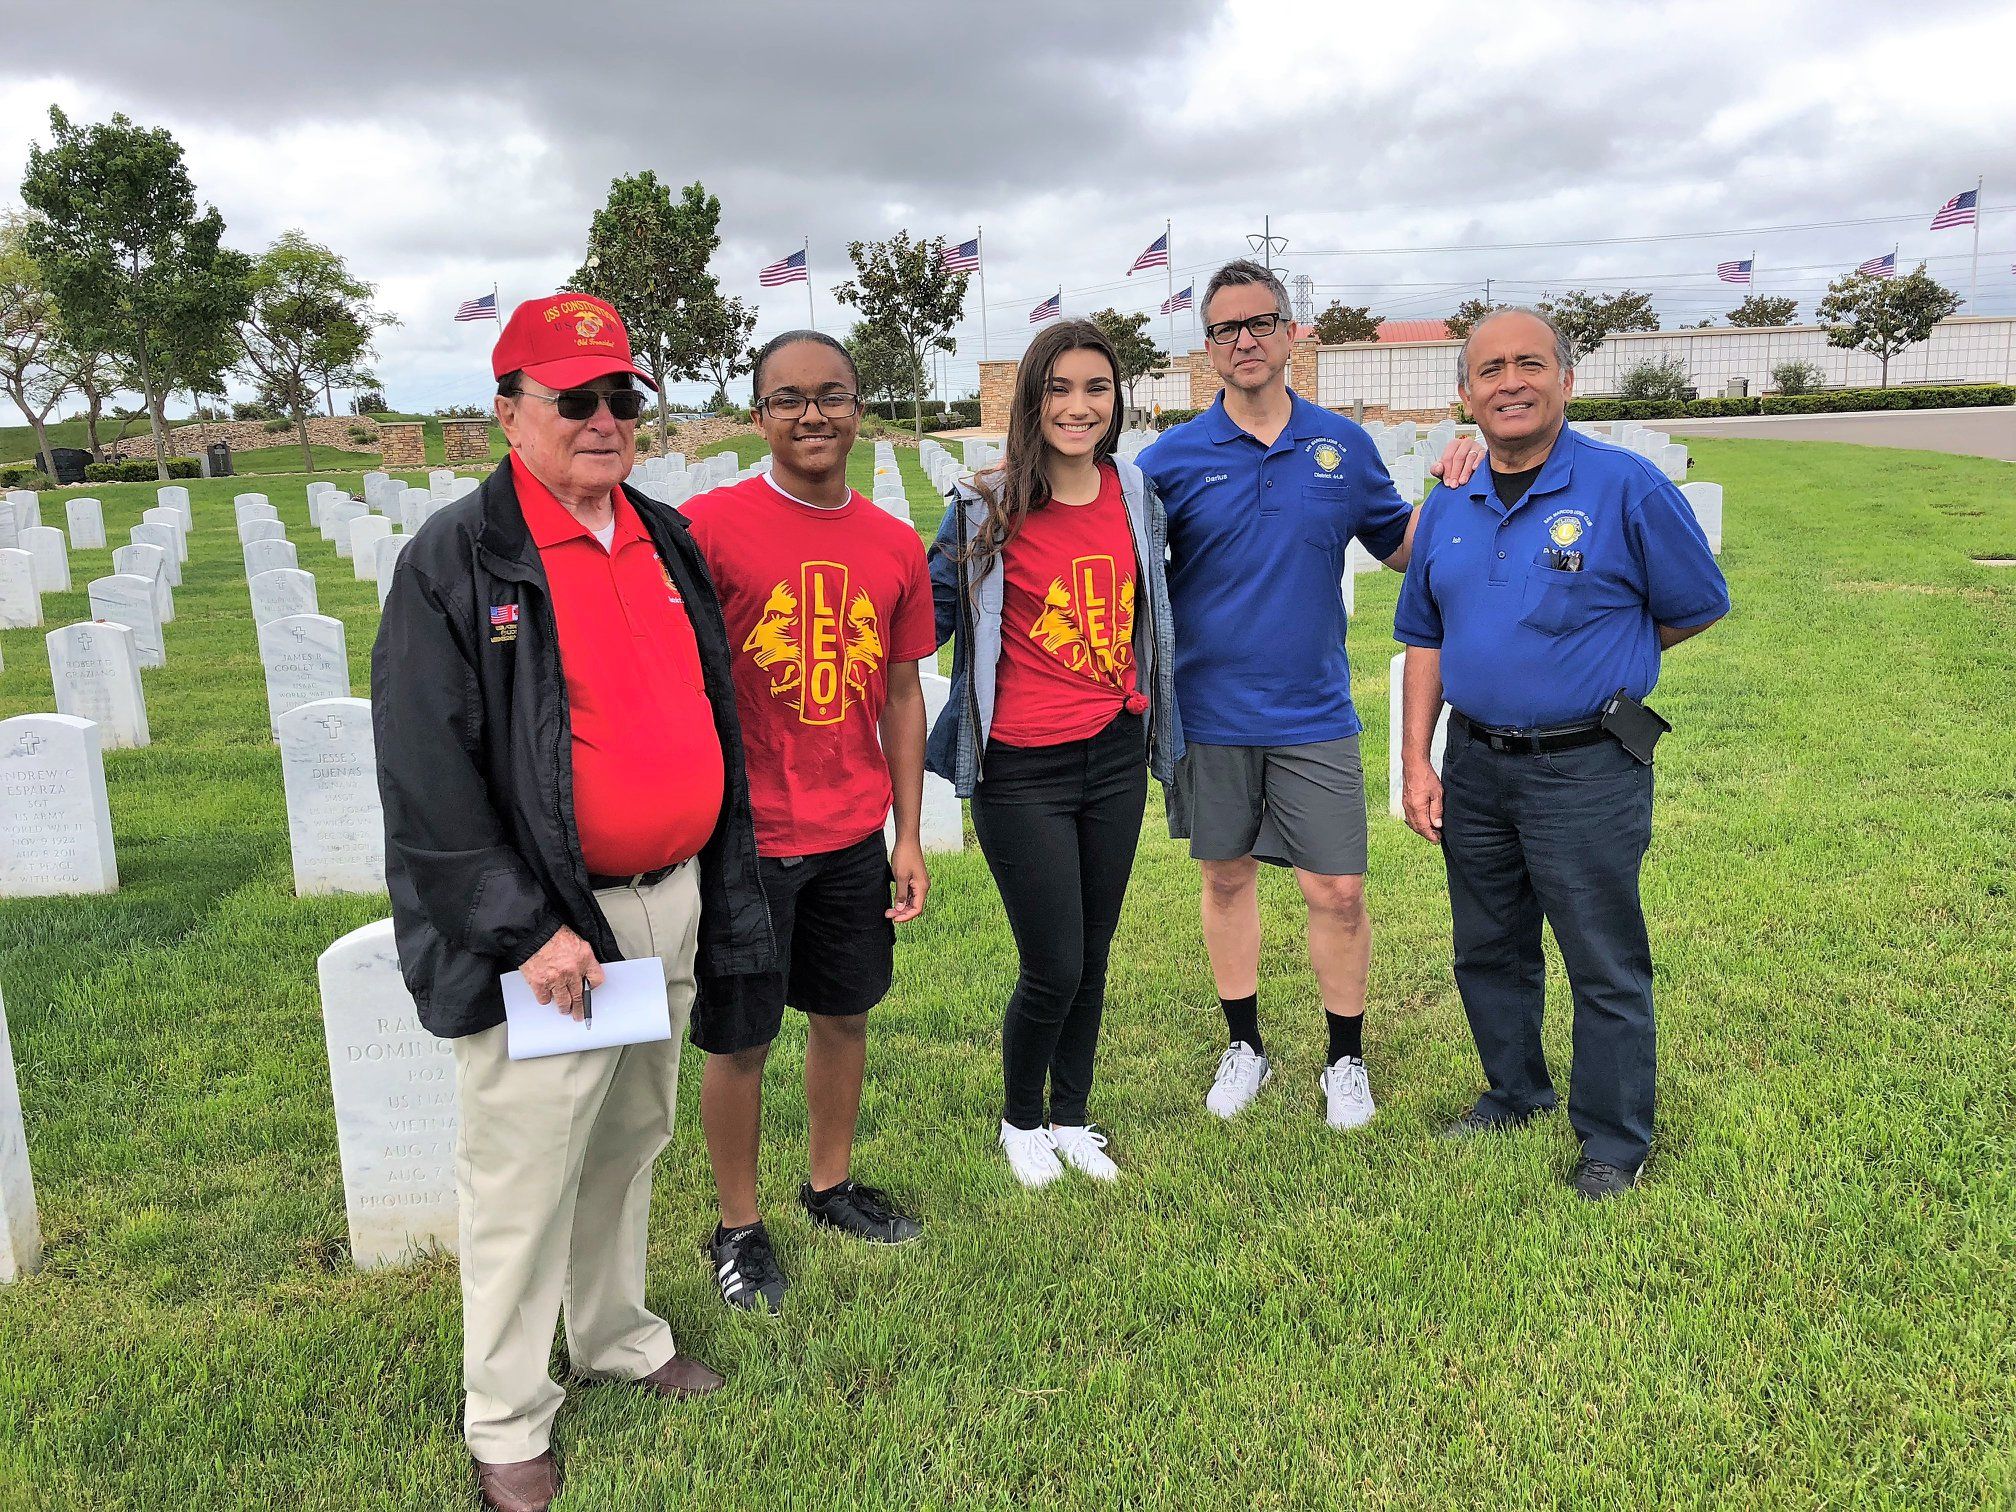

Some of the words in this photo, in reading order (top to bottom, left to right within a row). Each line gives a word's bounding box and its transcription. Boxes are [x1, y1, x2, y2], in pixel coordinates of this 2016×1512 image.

[543, 306, 561, 323] USS
[1205, 474, 1228, 483] Darius
[810, 573, 838, 704] LEO
[281, 652, 312, 662] JAMES
[273, 664, 314, 672] COOLEY
[315, 752, 347, 764] JESSE
[311, 765, 363, 780] DUENAS
[7, 784, 66, 796] ESPARZA
[28, 799, 49, 809] SGT
[19, 875, 49, 884] WITH
[388, 1094, 410, 1109] US
[384, 1143, 423, 1159] AUG
[388, 1167, 426, 1182] AUG
[360, 1191, 443, 1208] PROUDLY
